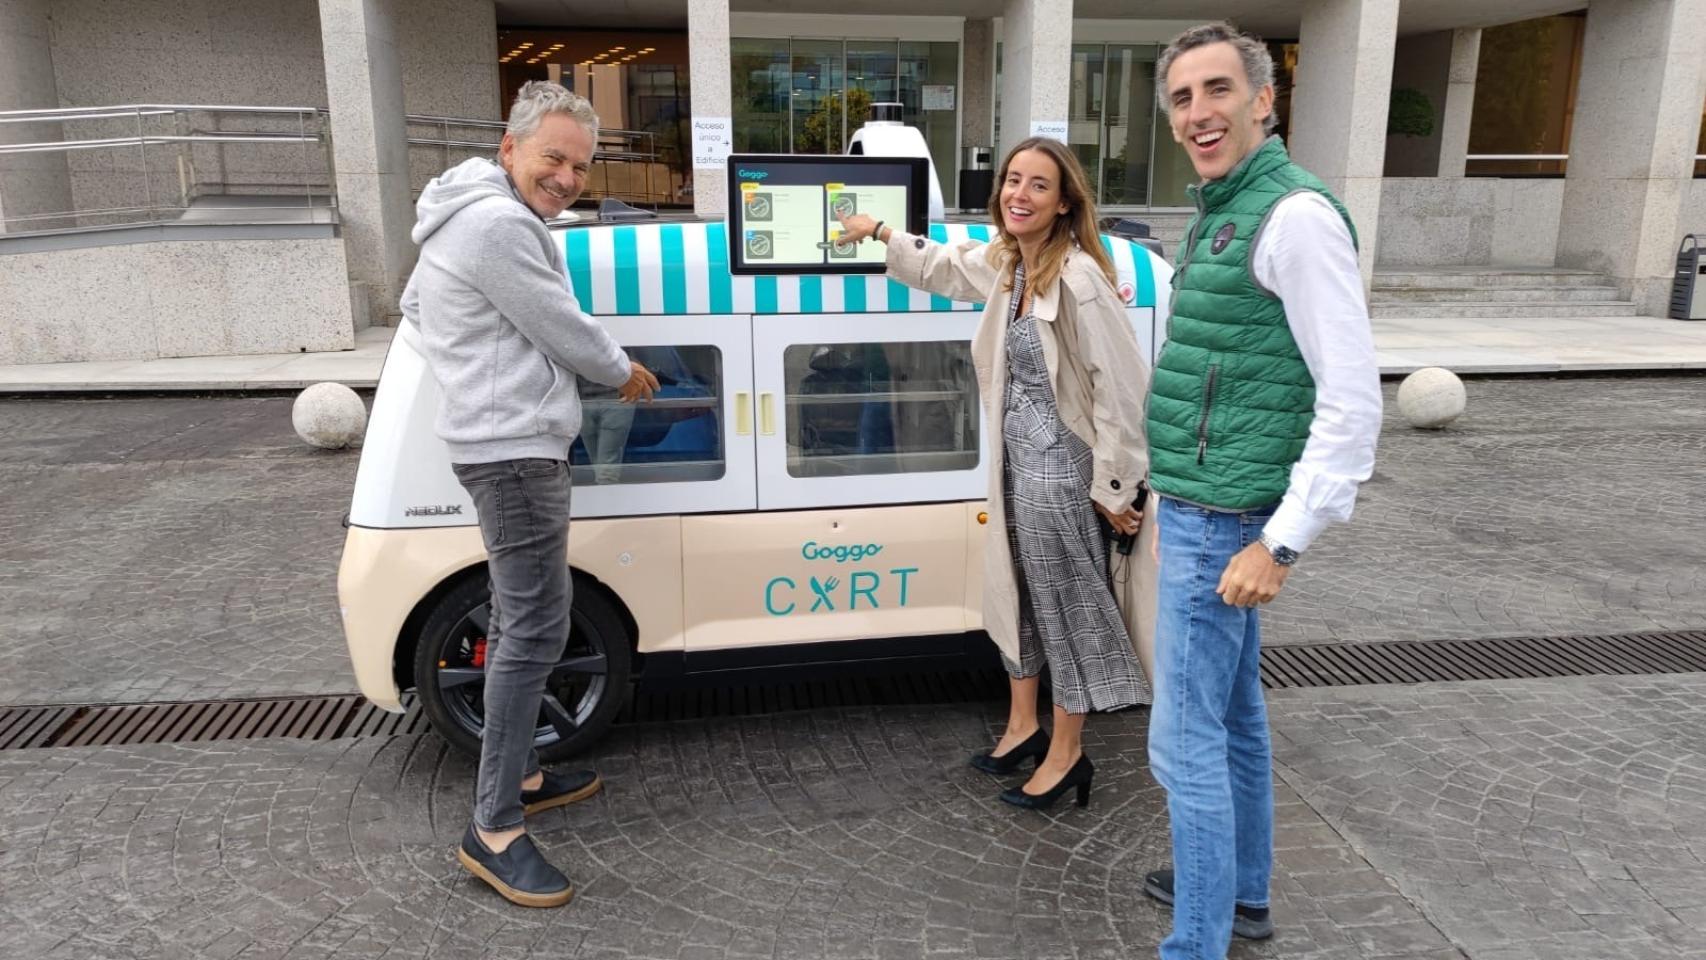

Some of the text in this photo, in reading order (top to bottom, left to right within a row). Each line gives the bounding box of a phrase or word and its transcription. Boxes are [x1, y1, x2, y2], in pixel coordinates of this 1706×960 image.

[695, 121, 725, 130] Acceso
[1038, 125, 1065, 133] Acceso
[739, 169, 768, 180] Goggo
[802, 541, 884, 563] Goggo
